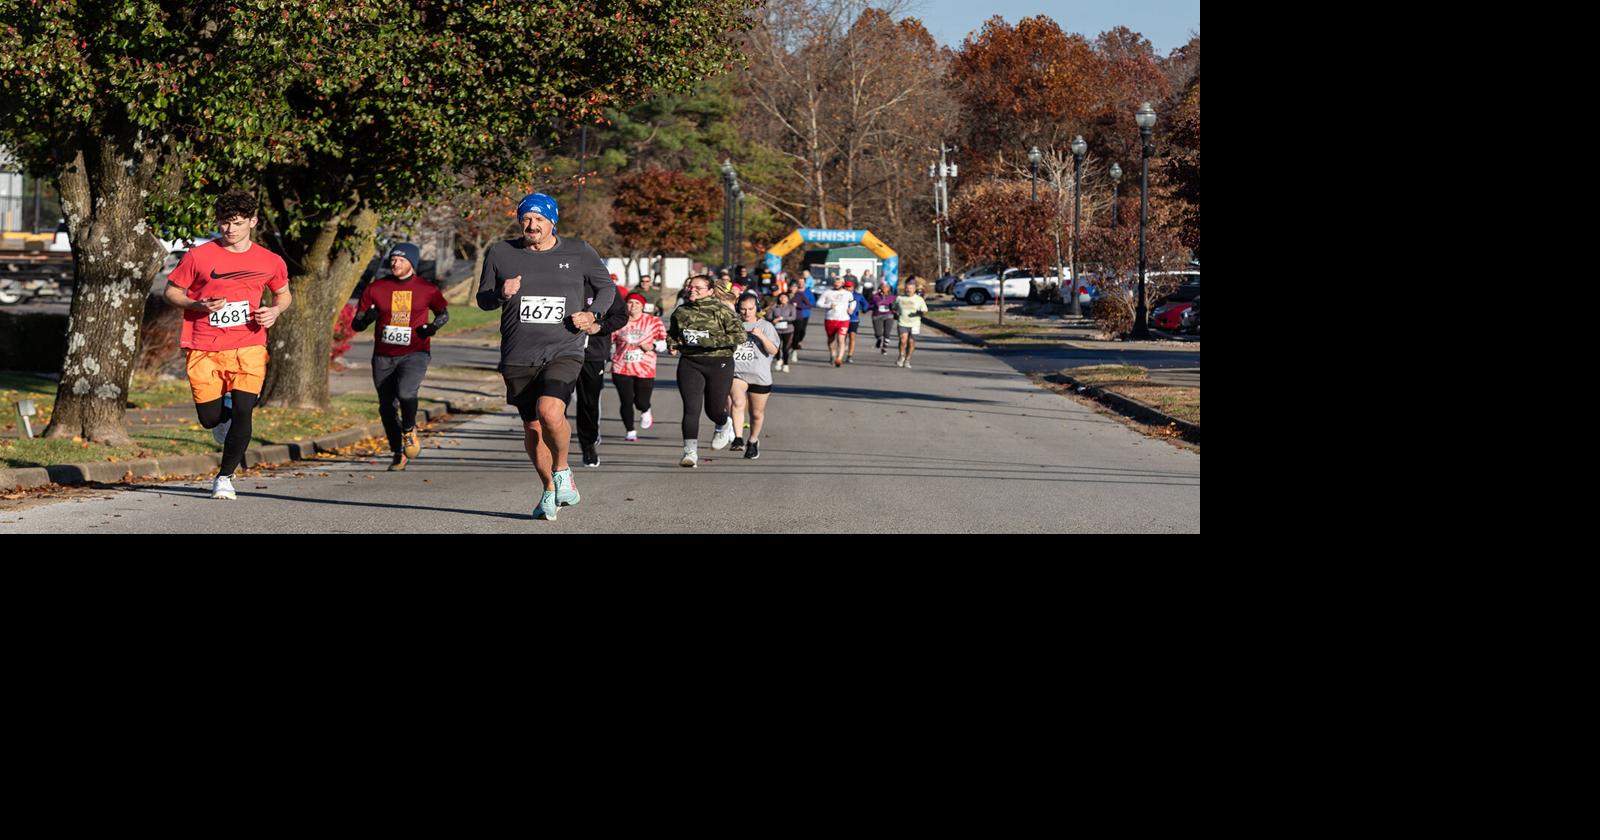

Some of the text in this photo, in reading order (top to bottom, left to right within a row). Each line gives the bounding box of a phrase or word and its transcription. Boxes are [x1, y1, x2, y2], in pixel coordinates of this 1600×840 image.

[808, 230, 856, 241] FINISH
[211, 309, 248, 324] 4681
[521, 305, 564, 320] 4673
[383, 331, 410, 343] 4685
